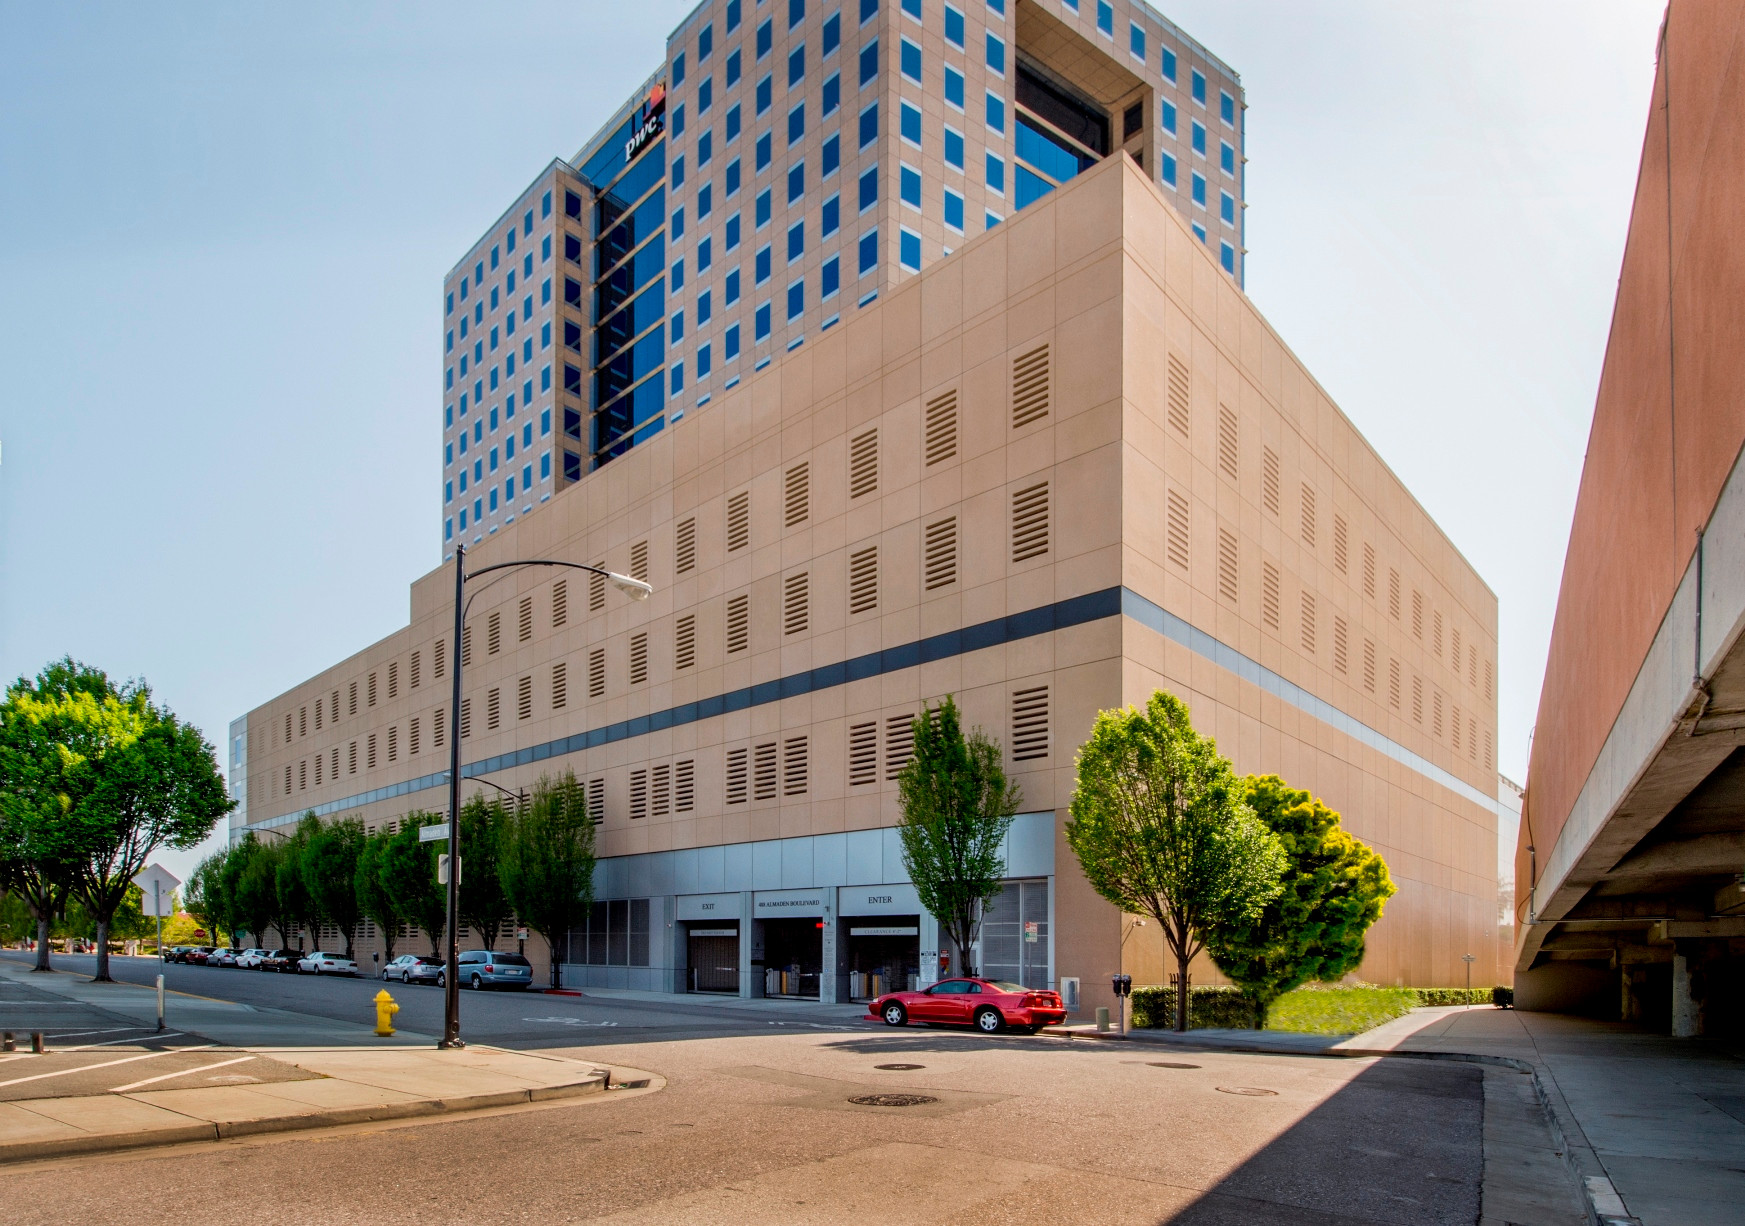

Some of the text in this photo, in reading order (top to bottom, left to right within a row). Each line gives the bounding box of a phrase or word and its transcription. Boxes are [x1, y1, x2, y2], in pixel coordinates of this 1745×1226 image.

[625, 116, 657, 162] pwc
[789, 899, 820, 907] BOULEVARD
[868, 896, 893, 904] ENTER
